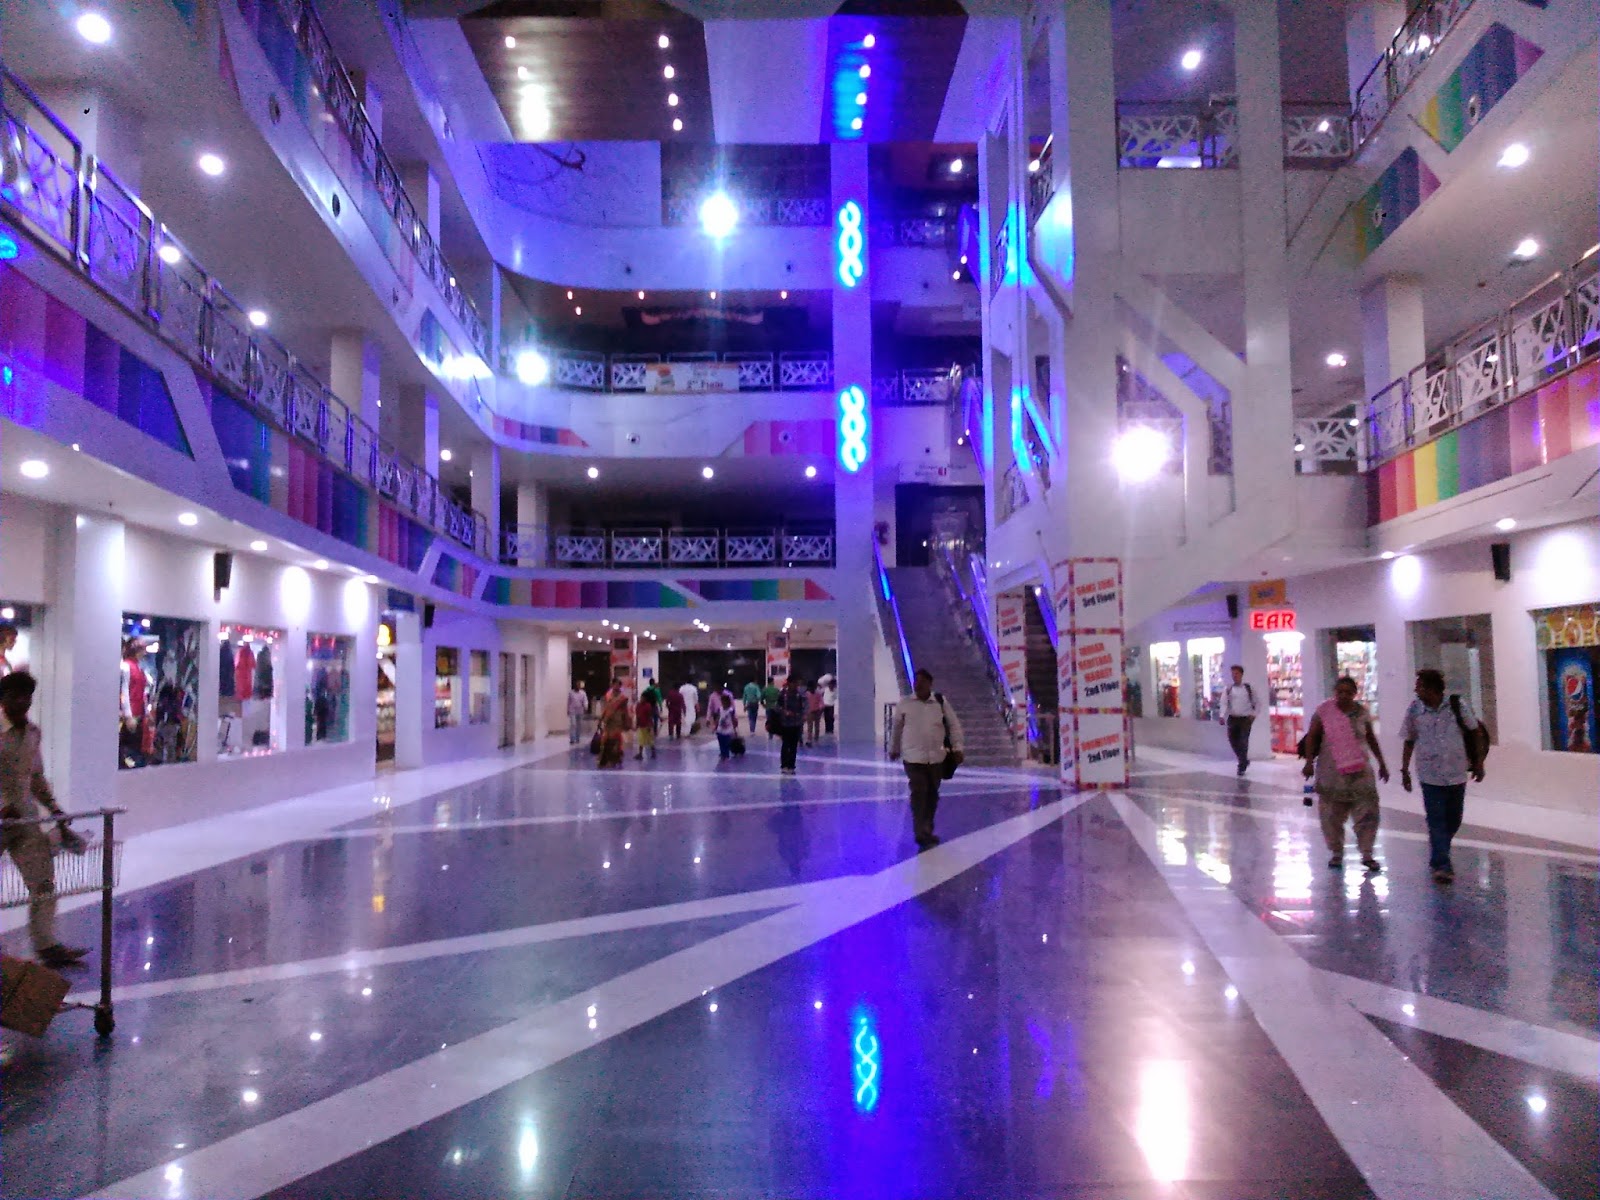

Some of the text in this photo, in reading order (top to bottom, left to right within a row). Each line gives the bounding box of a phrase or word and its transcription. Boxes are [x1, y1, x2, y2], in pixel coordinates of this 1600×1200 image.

[1096, 592, 1115, 604] Floor
[1252, 610, 1295, 630] EAR
[1084, 681, 1119, 697] 2nd Floor
[1087, 748, 1120, 763] 2nd Floor
